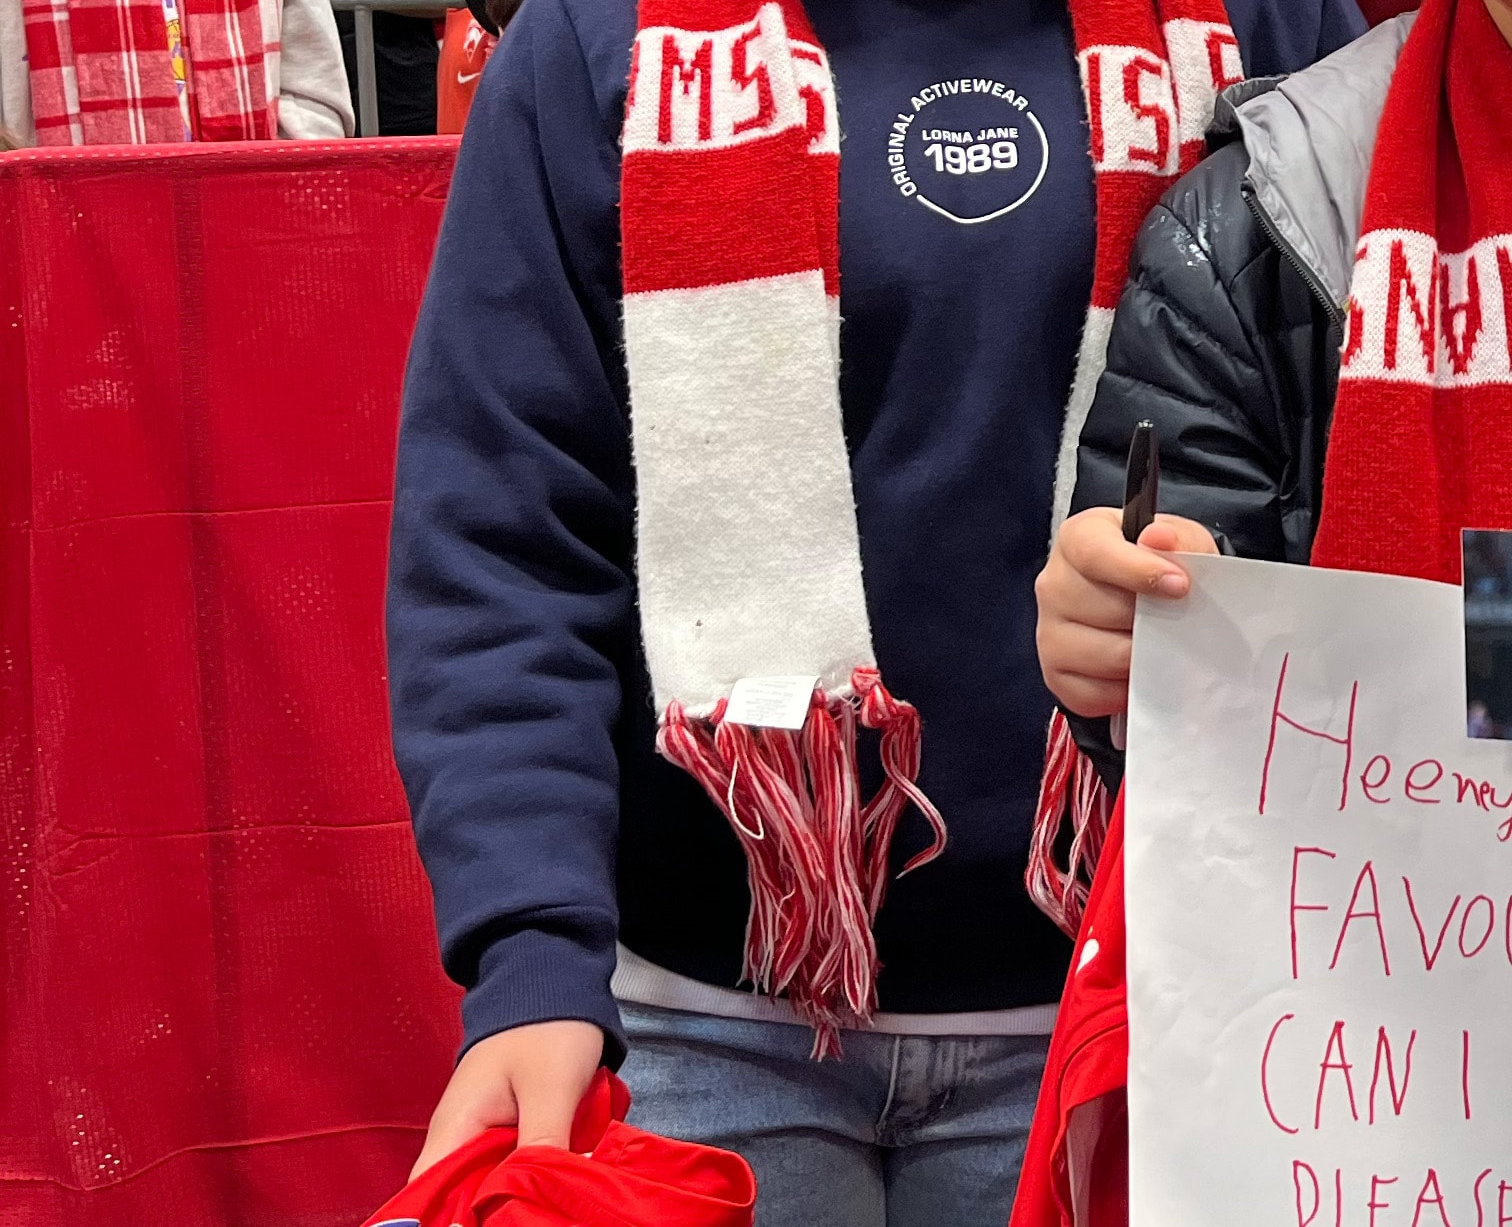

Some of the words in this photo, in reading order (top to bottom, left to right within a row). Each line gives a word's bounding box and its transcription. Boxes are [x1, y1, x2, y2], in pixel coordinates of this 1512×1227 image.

[910, 78, 1029, 112] ACTIVEWEAR
[921, 129, 974, 144] LORNA
[976, 127, 1019, 141] JANE
[887, 112, 917, 197] ORIGINAL
[923, 141, 1019, 175] 1989
[1261, 1013, 1416, 1135] CAN
[1461, 1029, 1473, 1121] I
